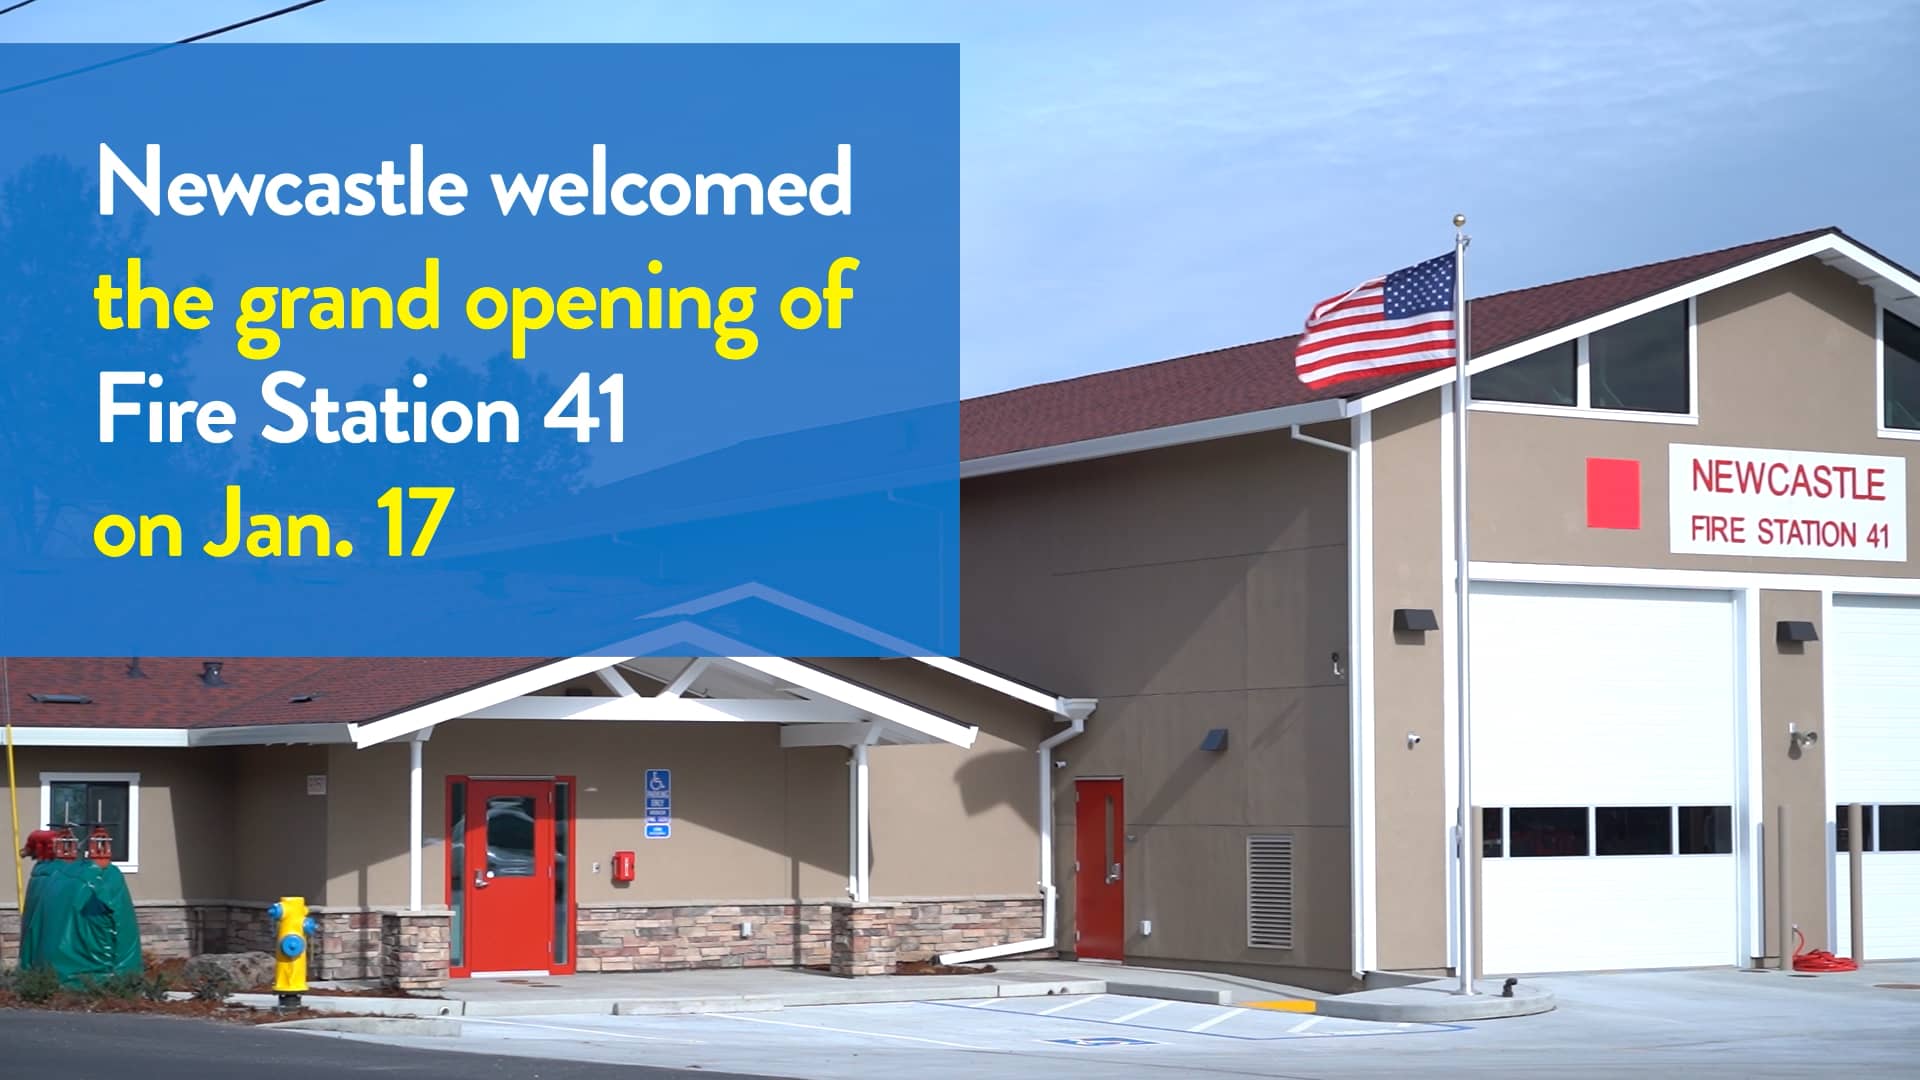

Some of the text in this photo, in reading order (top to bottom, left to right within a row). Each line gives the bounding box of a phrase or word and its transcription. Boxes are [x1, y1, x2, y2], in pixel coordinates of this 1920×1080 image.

[1692, 458, 1886, 501] NEWCASTLE
[1691, 515, 1889, 548] FIRE STATION 41
